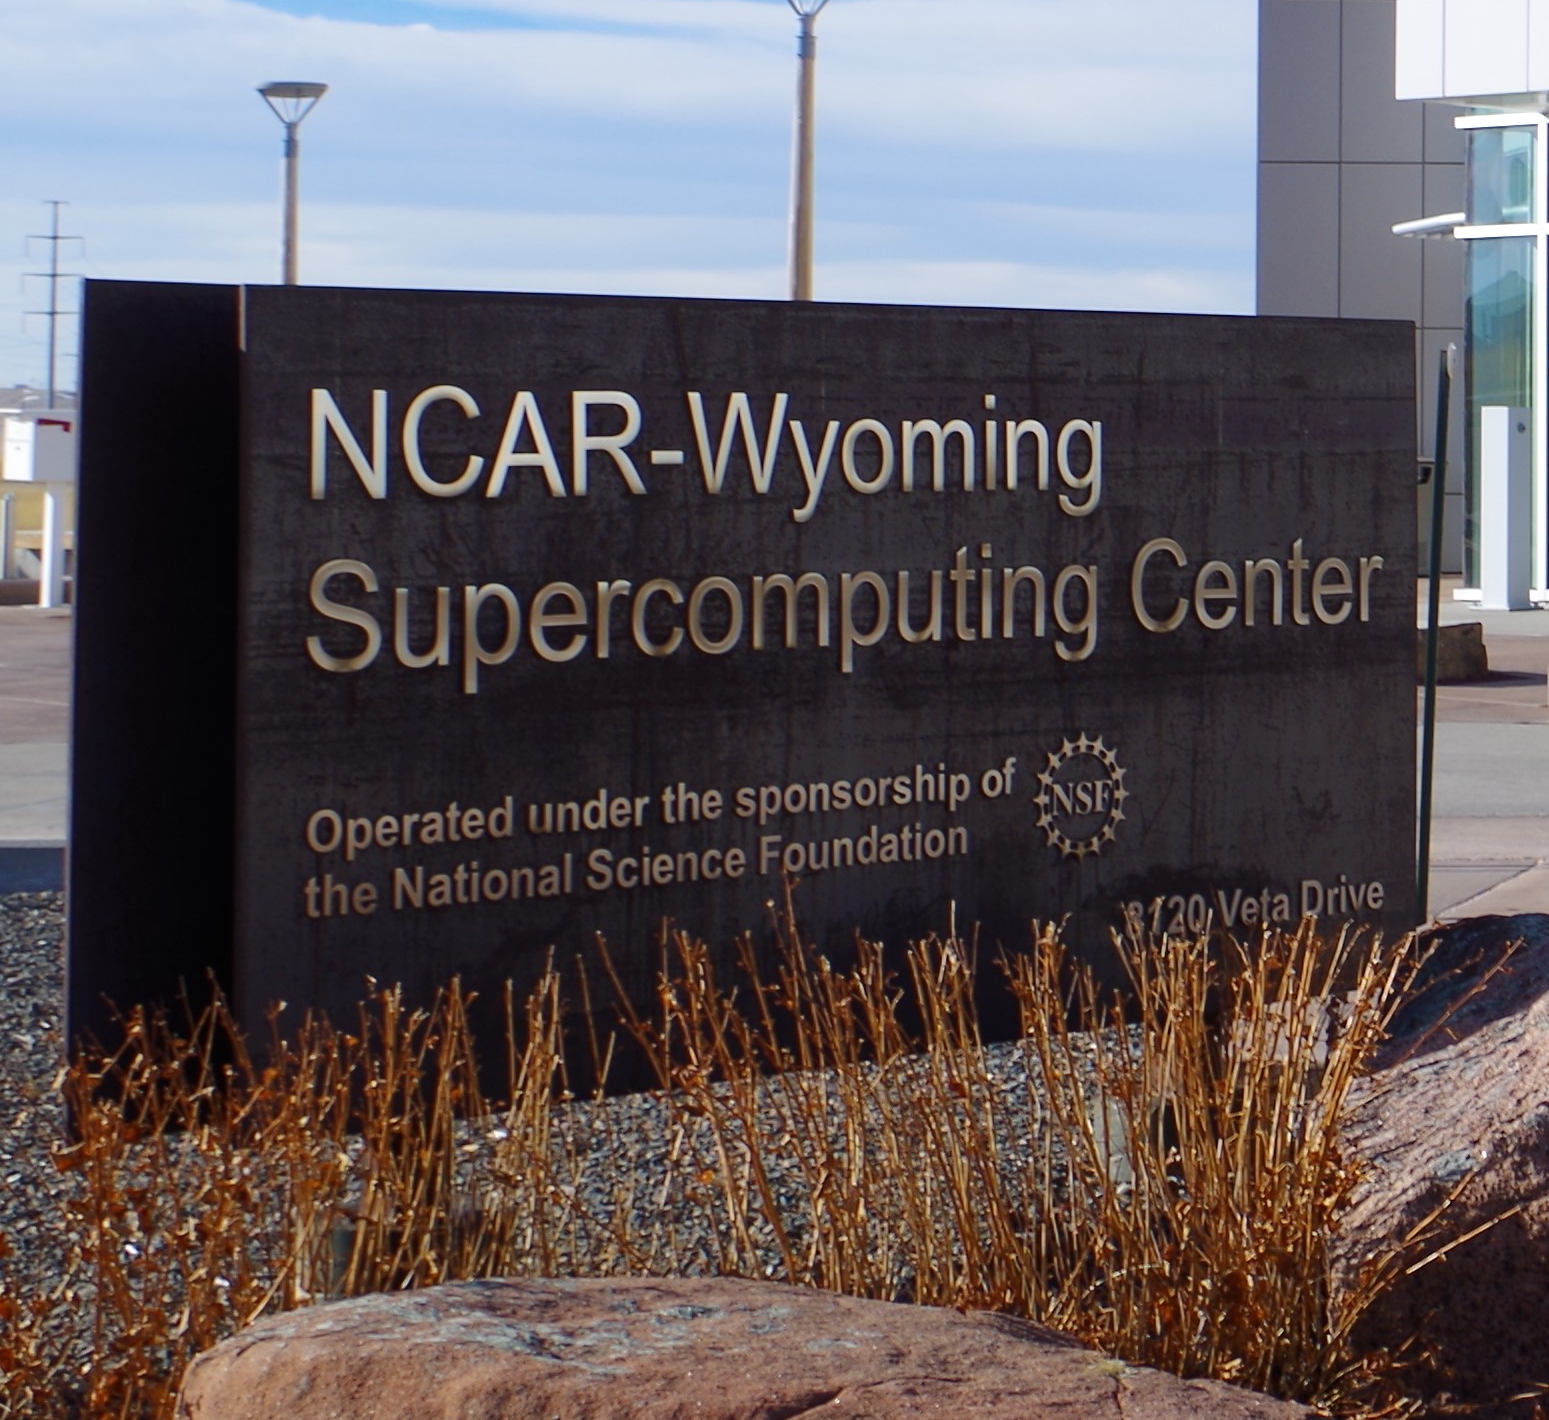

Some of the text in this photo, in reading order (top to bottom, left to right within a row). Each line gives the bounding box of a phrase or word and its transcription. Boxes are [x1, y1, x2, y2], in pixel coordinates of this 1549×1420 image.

[310, 384, 1103, 522] NCAR-Wyoming
[306, 537, 1385, 695] Supercomputing Center
[306, 757, 1017, 862] Operated under the sponsorship of
[1050, 780, 1114, 817] NSF
[305, 822, 969, 919] the National Science Foundation
[1217, 888, 1290, 928] Veta
[1301, 874, 1385, 917] Drive
